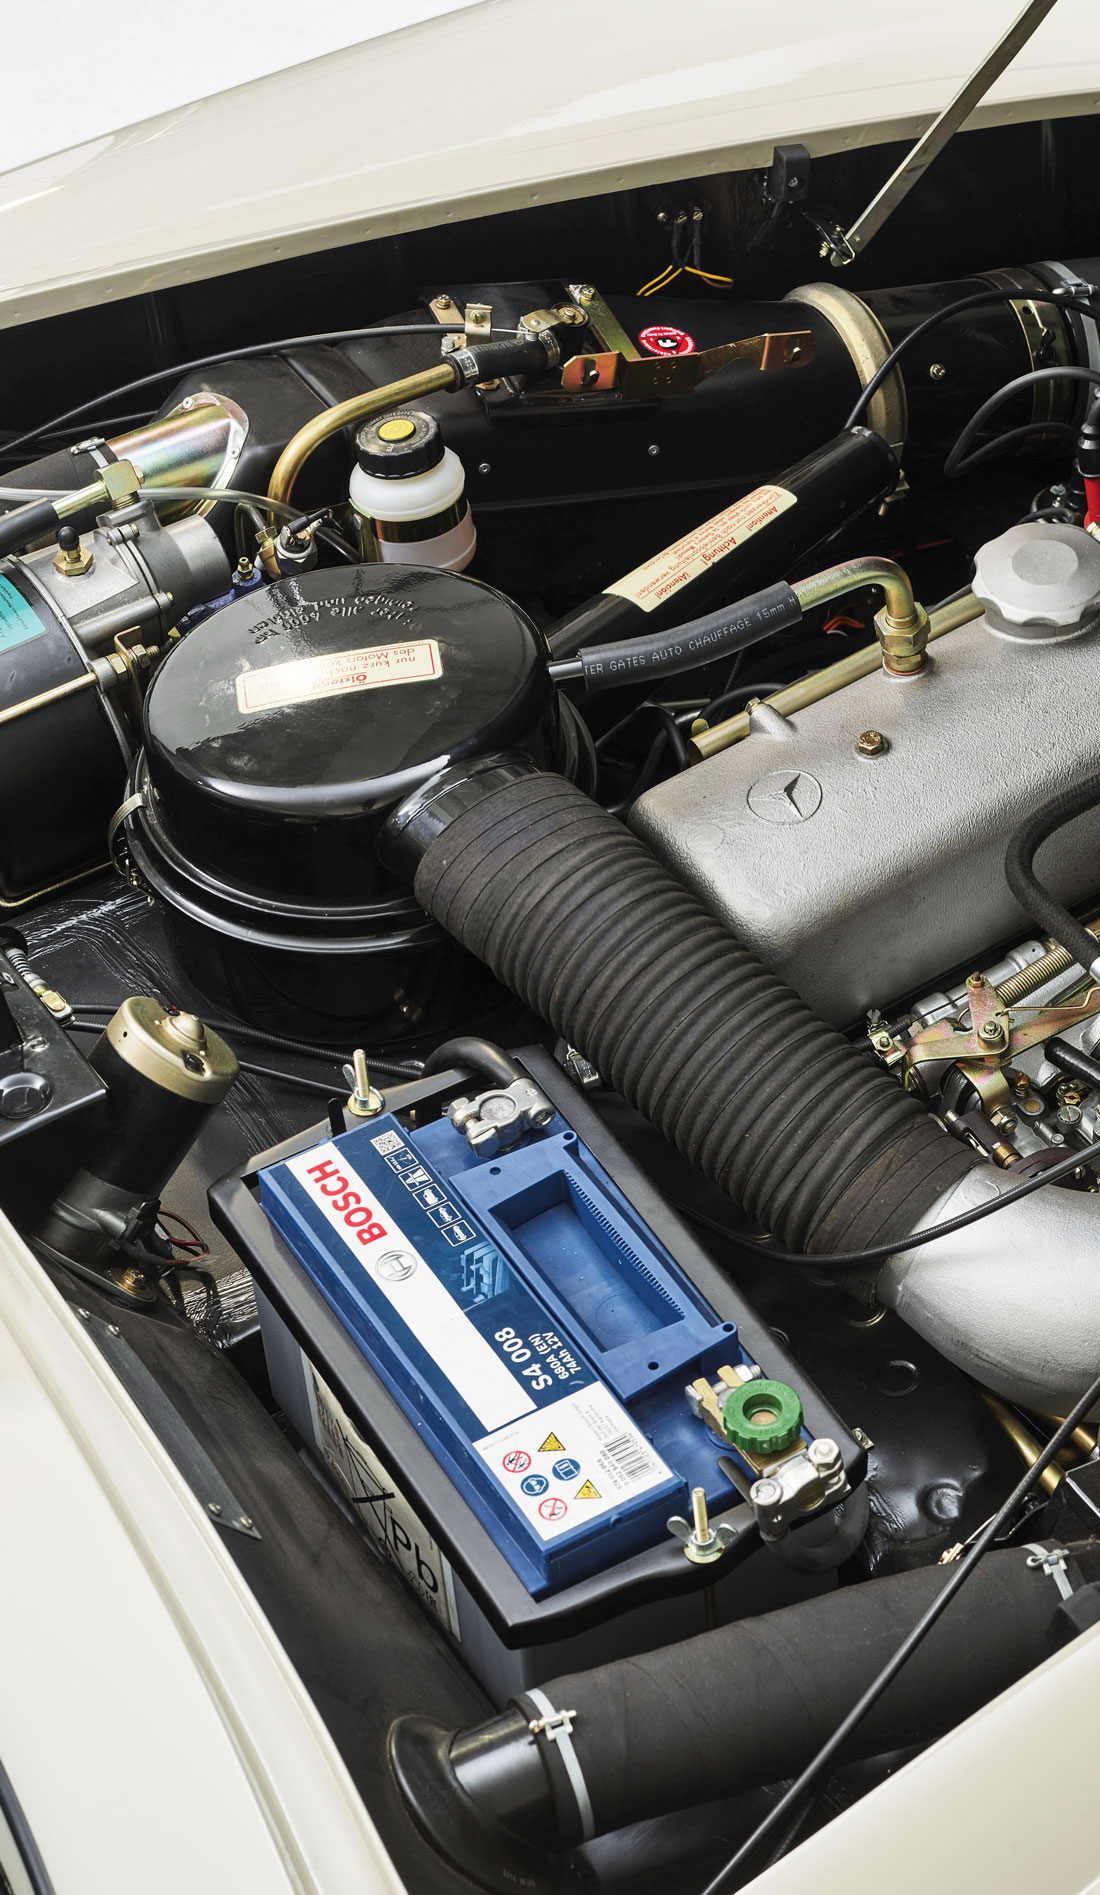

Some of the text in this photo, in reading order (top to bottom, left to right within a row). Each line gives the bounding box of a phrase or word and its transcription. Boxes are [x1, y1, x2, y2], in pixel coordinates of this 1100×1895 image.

[745, 505, 778, 532] Attention!
[700, 535, 736, 565] Achtung!
[345, 647, 414, 664] des Motors
[608, 654, 646, 672] GATES
[650, 644, 683, 662] AUTO
[687, 616, 752, 651] CHAUFFAGE
[755, 602, 785, 622] 15mm
[361, 659, 389, 671] kurz
[394, 655, 415, 665] nur
[305, 1159, 387, 1247] BOSCH
[492, 1324, 554, 1393] S4 008
[527, 1331, 569, 1380] 680A (EN)
[541, 1330, 581, 1373] 74Ah 12V
[391, 1515, 437, 1594] Pb
